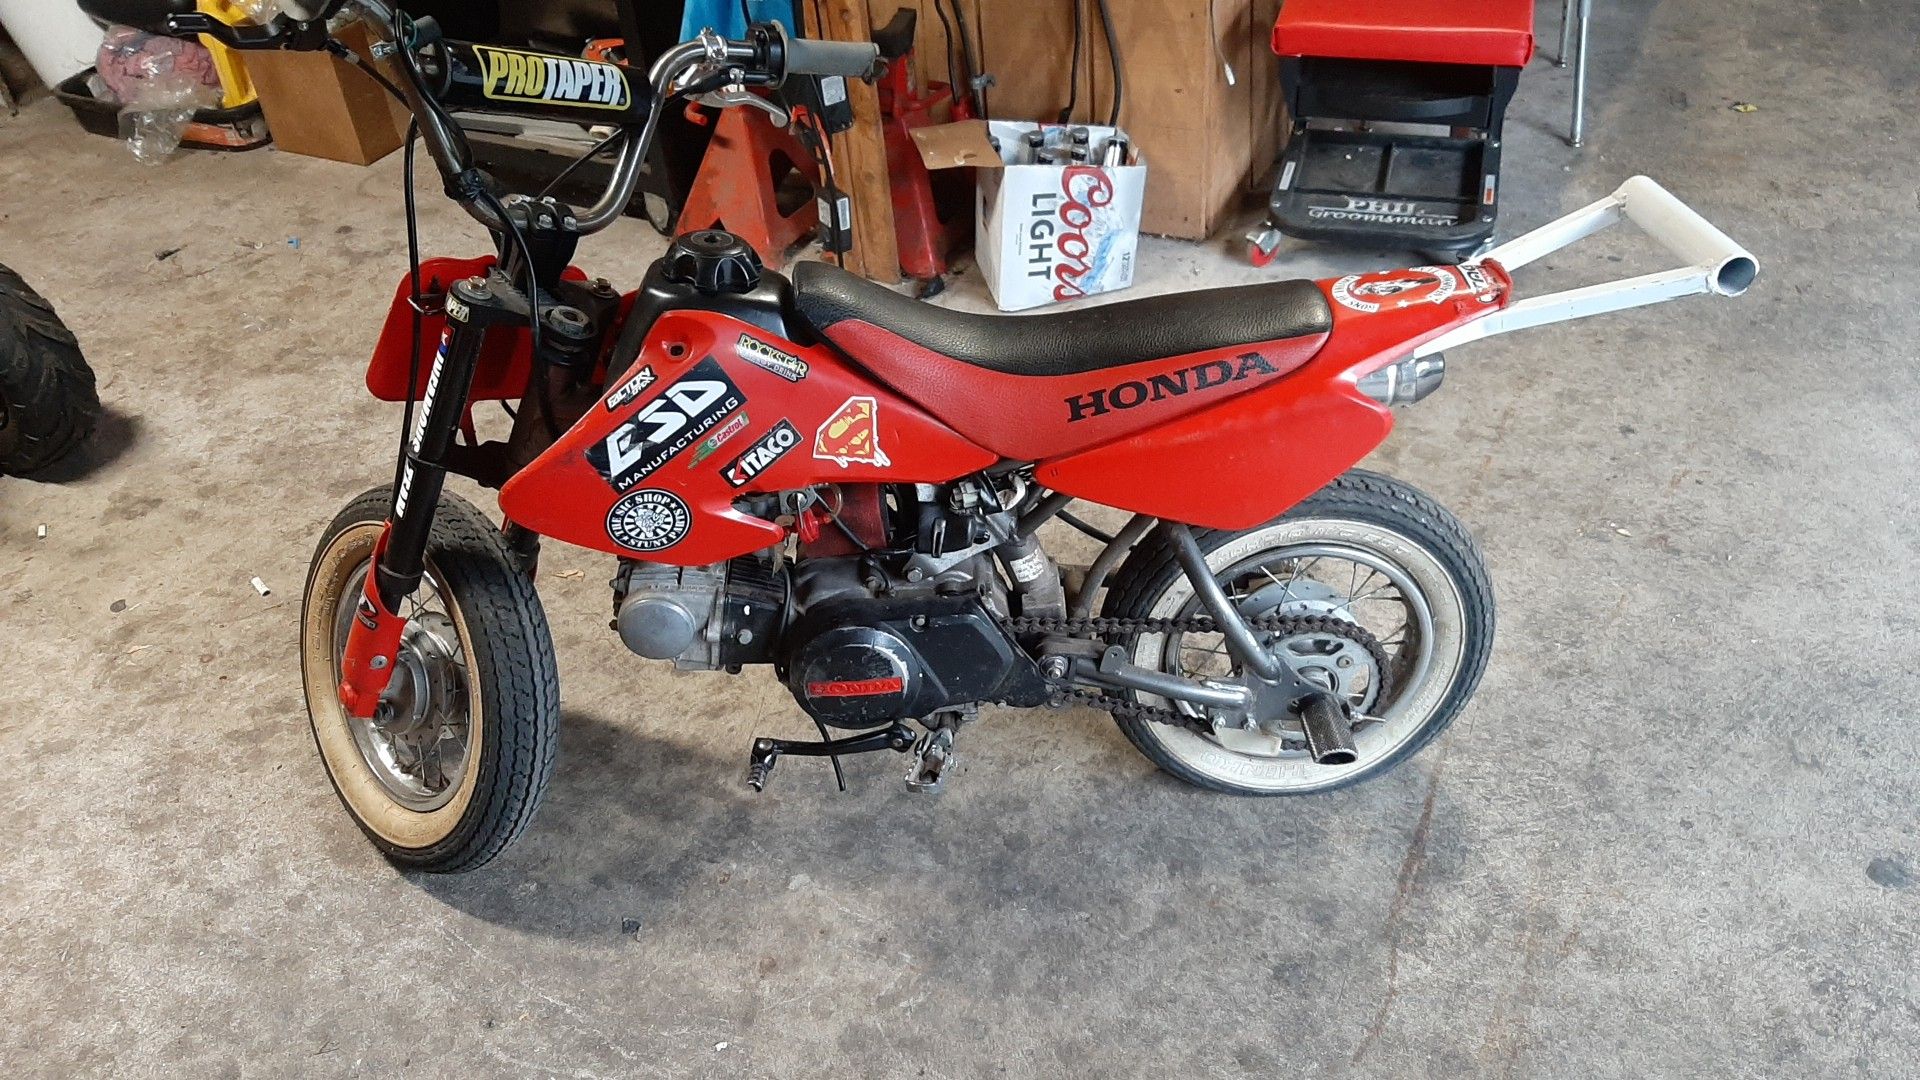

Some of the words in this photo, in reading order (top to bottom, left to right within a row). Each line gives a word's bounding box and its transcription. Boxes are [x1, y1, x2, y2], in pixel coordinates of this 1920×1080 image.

[1028, 193, 1057, 280] LIGHT
[1053, 165, 1113, 302] Coors
[740, 334, 808, 378] ROCKSTAR
[1064, 352, 1279, 423] HONDA
[618, 397, 739, 490] MANUFACTURING
[716, 418, 743, 442] Castrol
[727, 428, 795, 485] KITACO
[614, 499, 634, 516] SIC
[634, 493, 671, 505] SHOP
[611, 516, 625, 538] THE
[628, 537, 668, 548] STUNT
